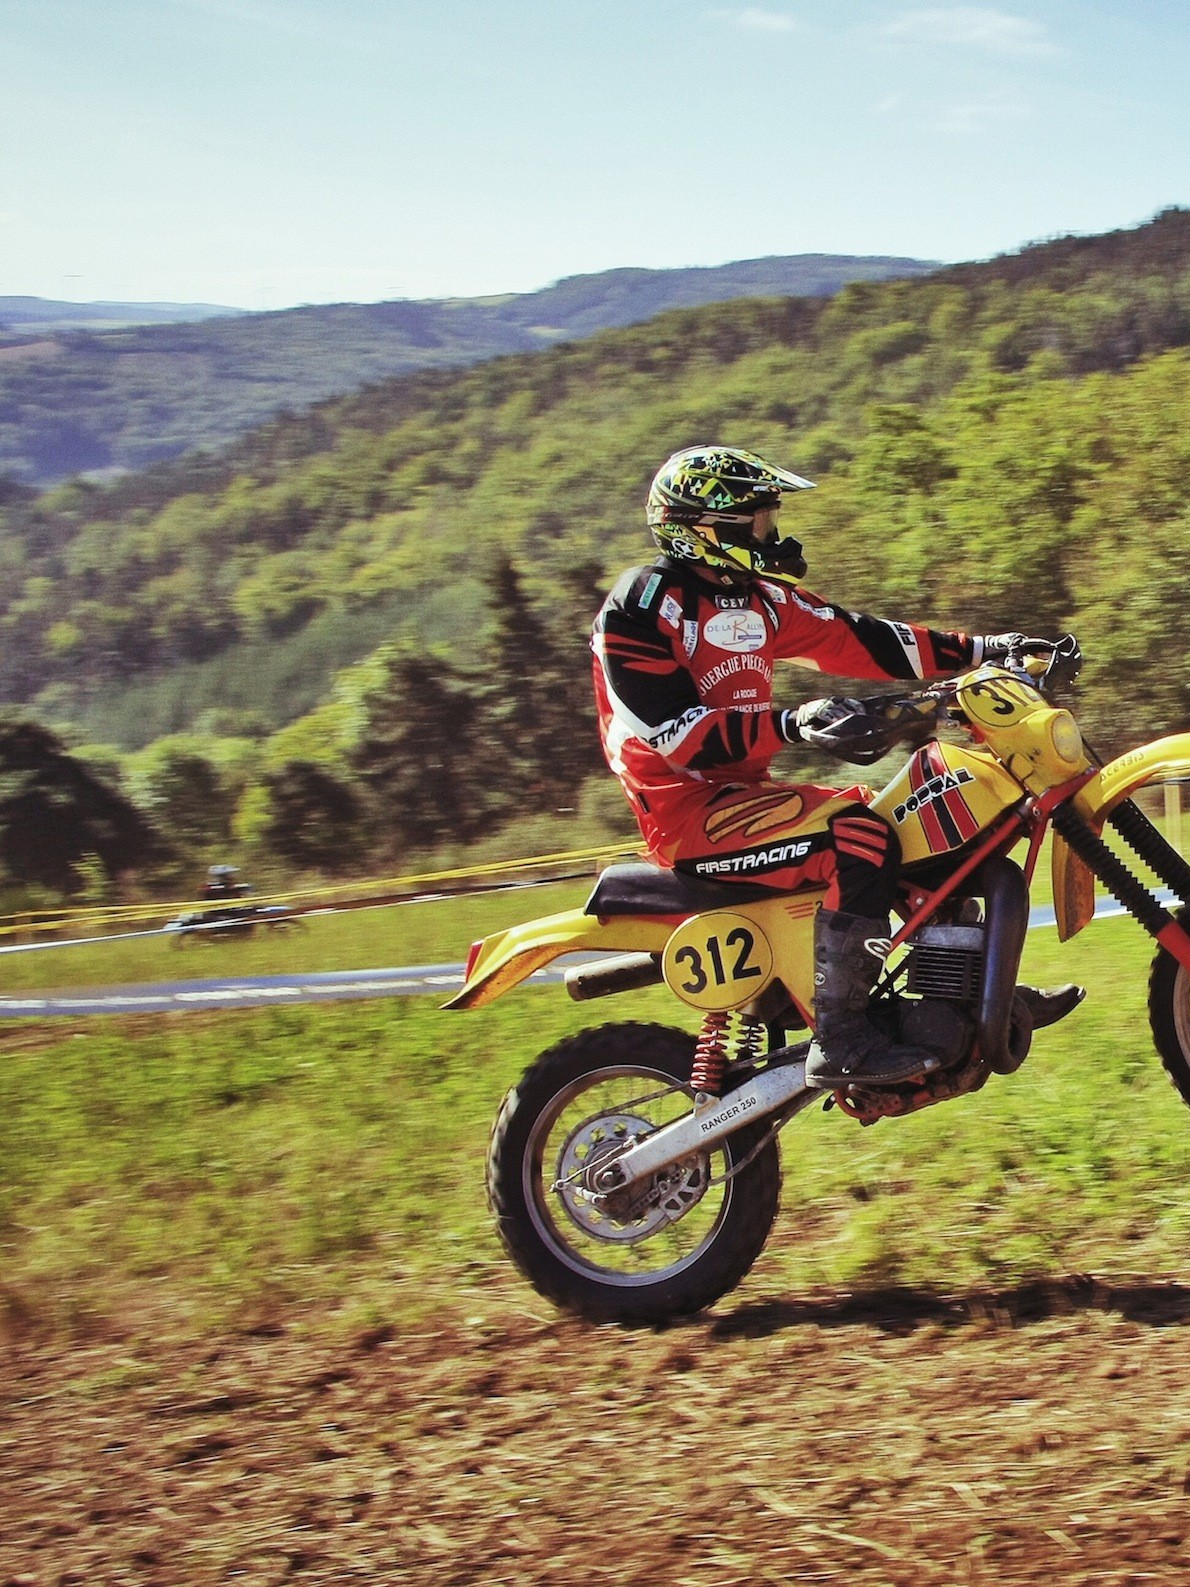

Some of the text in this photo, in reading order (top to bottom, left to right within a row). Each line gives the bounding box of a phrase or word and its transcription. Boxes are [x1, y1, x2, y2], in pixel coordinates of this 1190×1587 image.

[891, 766, 977, 825] PORTAL
[696, 841, 812, 874] FIRSTRACING
[675, 927, 763, 994] 312
[701, 1096, 757, 1133] RANGER 250
